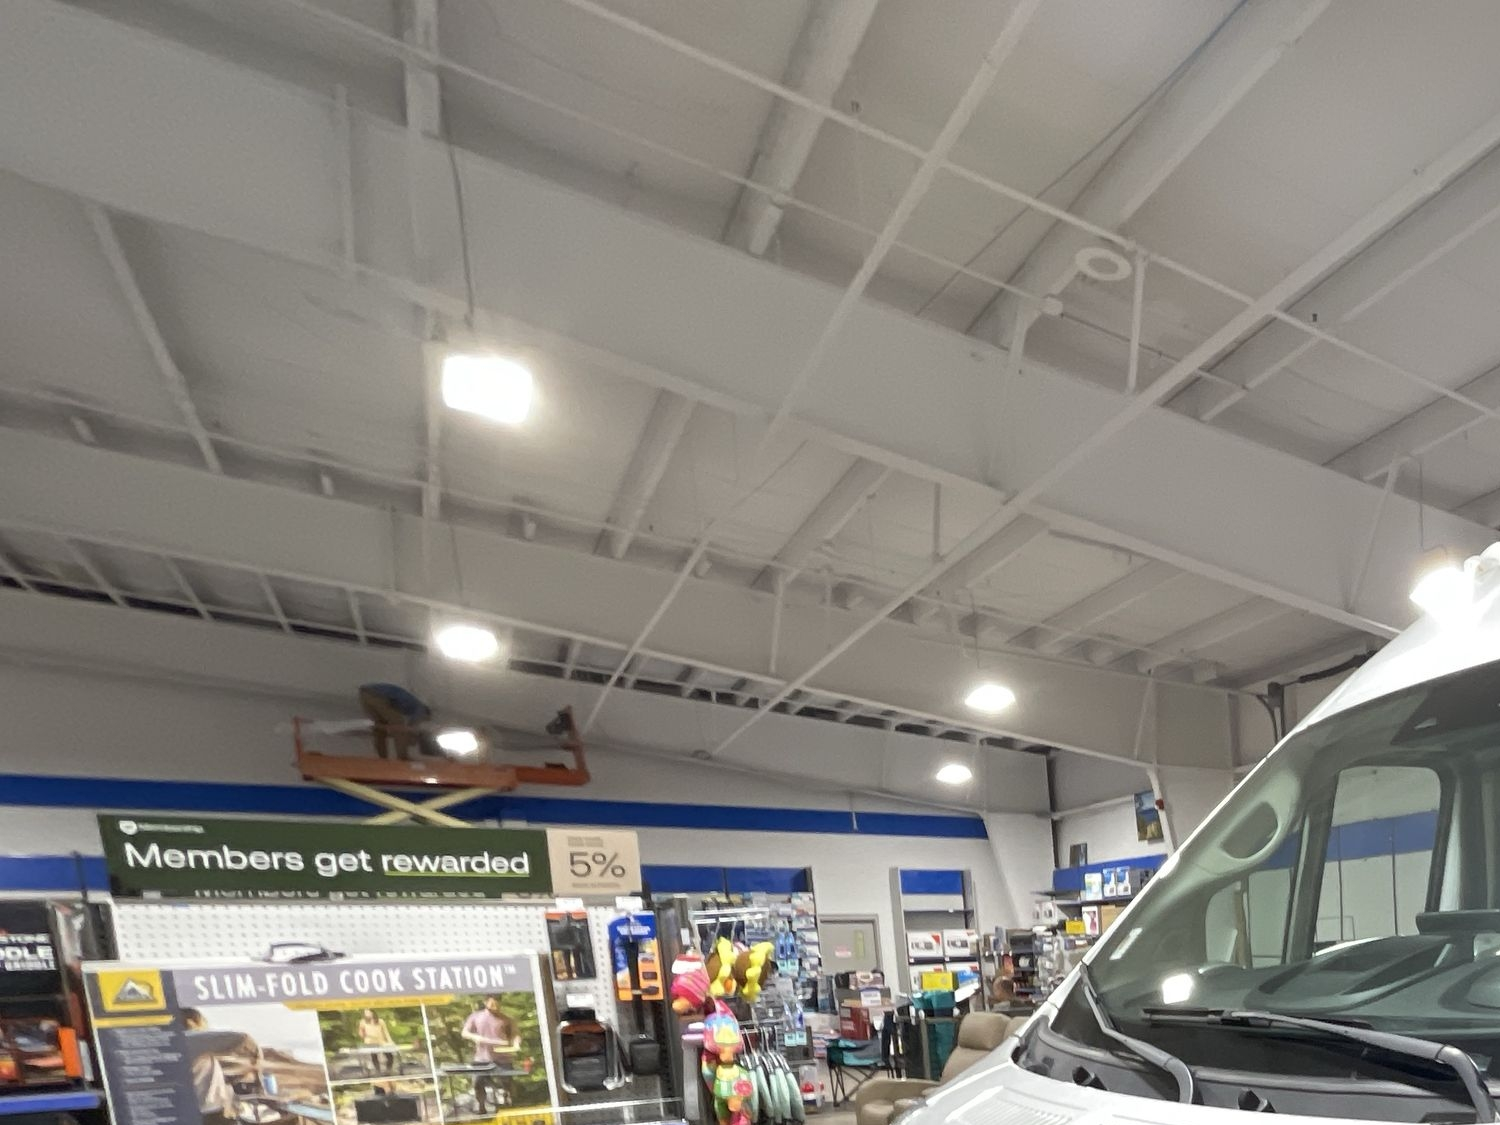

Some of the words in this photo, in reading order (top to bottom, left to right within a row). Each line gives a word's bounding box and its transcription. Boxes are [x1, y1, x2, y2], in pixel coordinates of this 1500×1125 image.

[124, 842, 305, 871] Members
[314, 850, 373, 877] get
[381, 851, 530, 876] rewarded
[569, 852, 626, 878] 5%
[194, 970, 329, 1000] SLIM-FOLD
[339, 966, 405, 994] COOK
